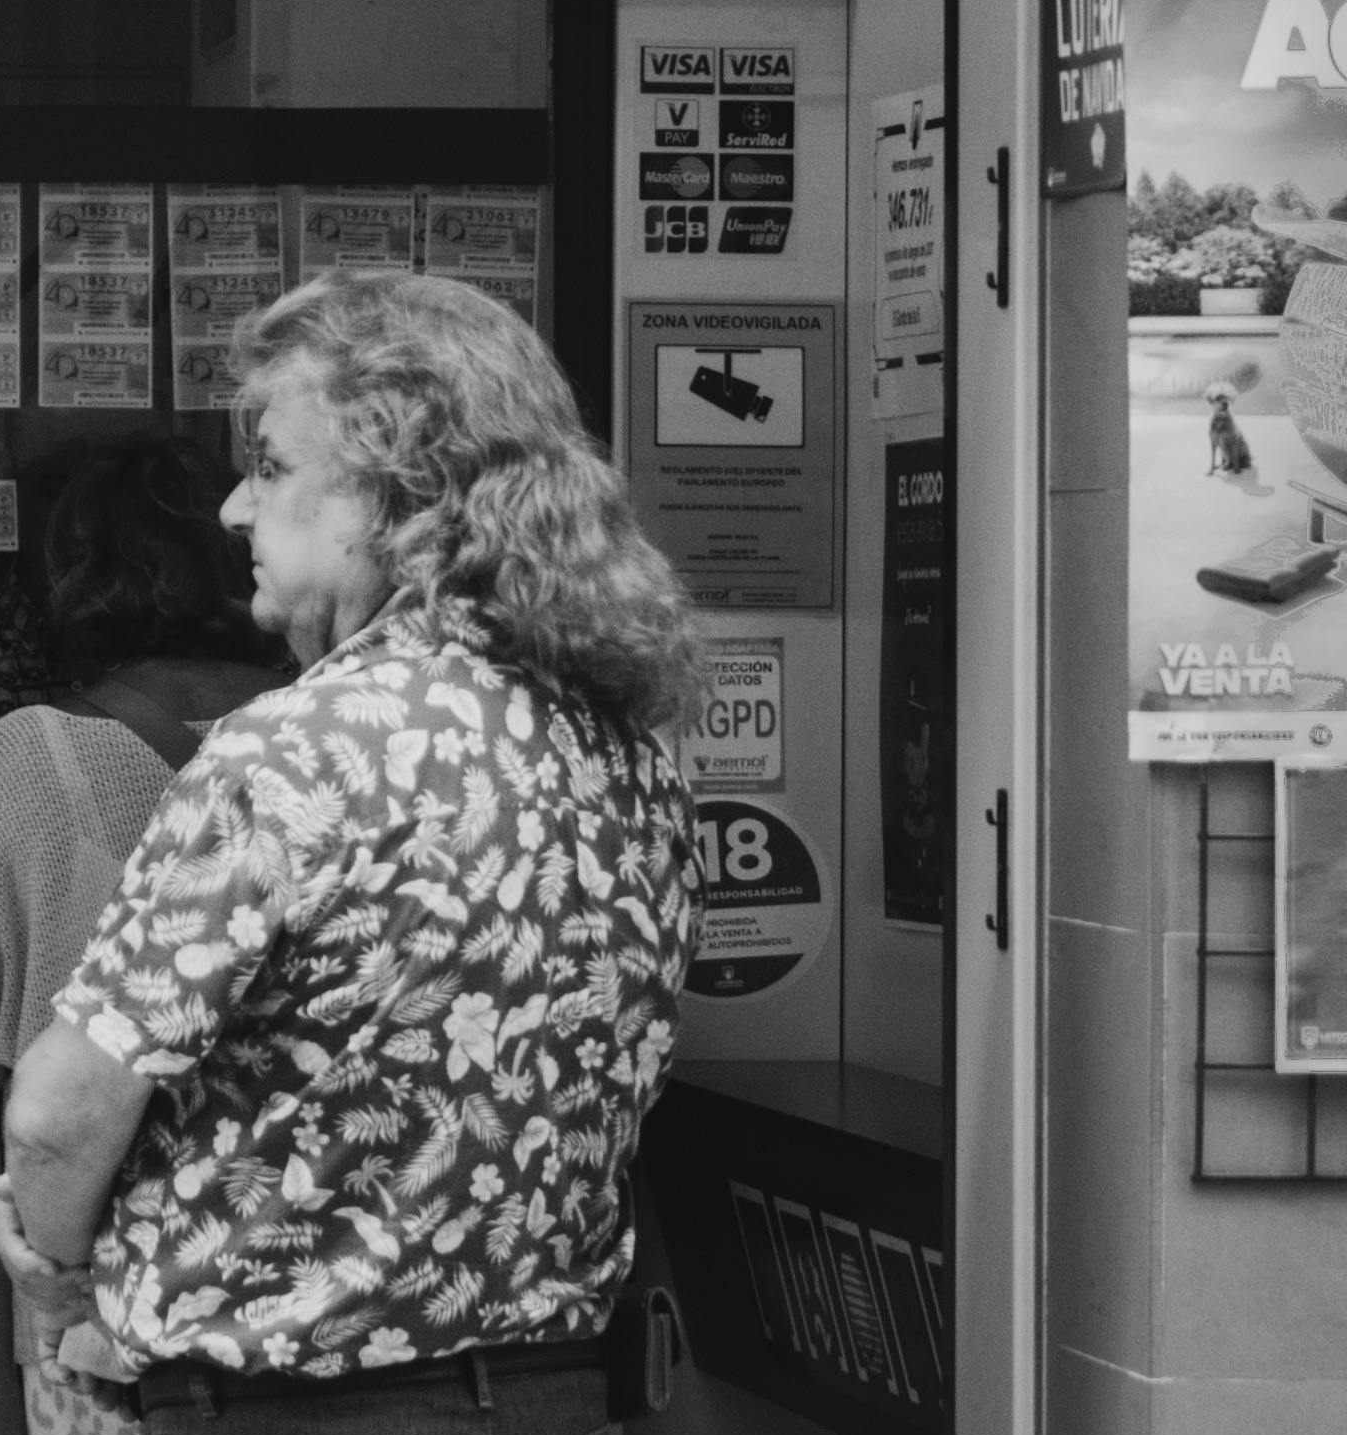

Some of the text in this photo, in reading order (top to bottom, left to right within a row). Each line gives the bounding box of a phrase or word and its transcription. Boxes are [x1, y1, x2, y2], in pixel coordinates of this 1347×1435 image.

[649, 53, 791, 77] VISA VISA
[668, 103, 689, 127] V
[665, 131, 787, 147] PAY ServiRed
[645, 171, 711, 185] MasterCard
[645, 221, 707, 239] JCB
[642, 314, 823, 330] ZONA VIDEOVIGILADA
[1158, 640, 1296, 669] YA A LA
[718, 674, 762, 686] DATOS
[1157, 667, 1295, 697] VENTA
[706, 886, 805, 902] RESPONSABILIDAD
